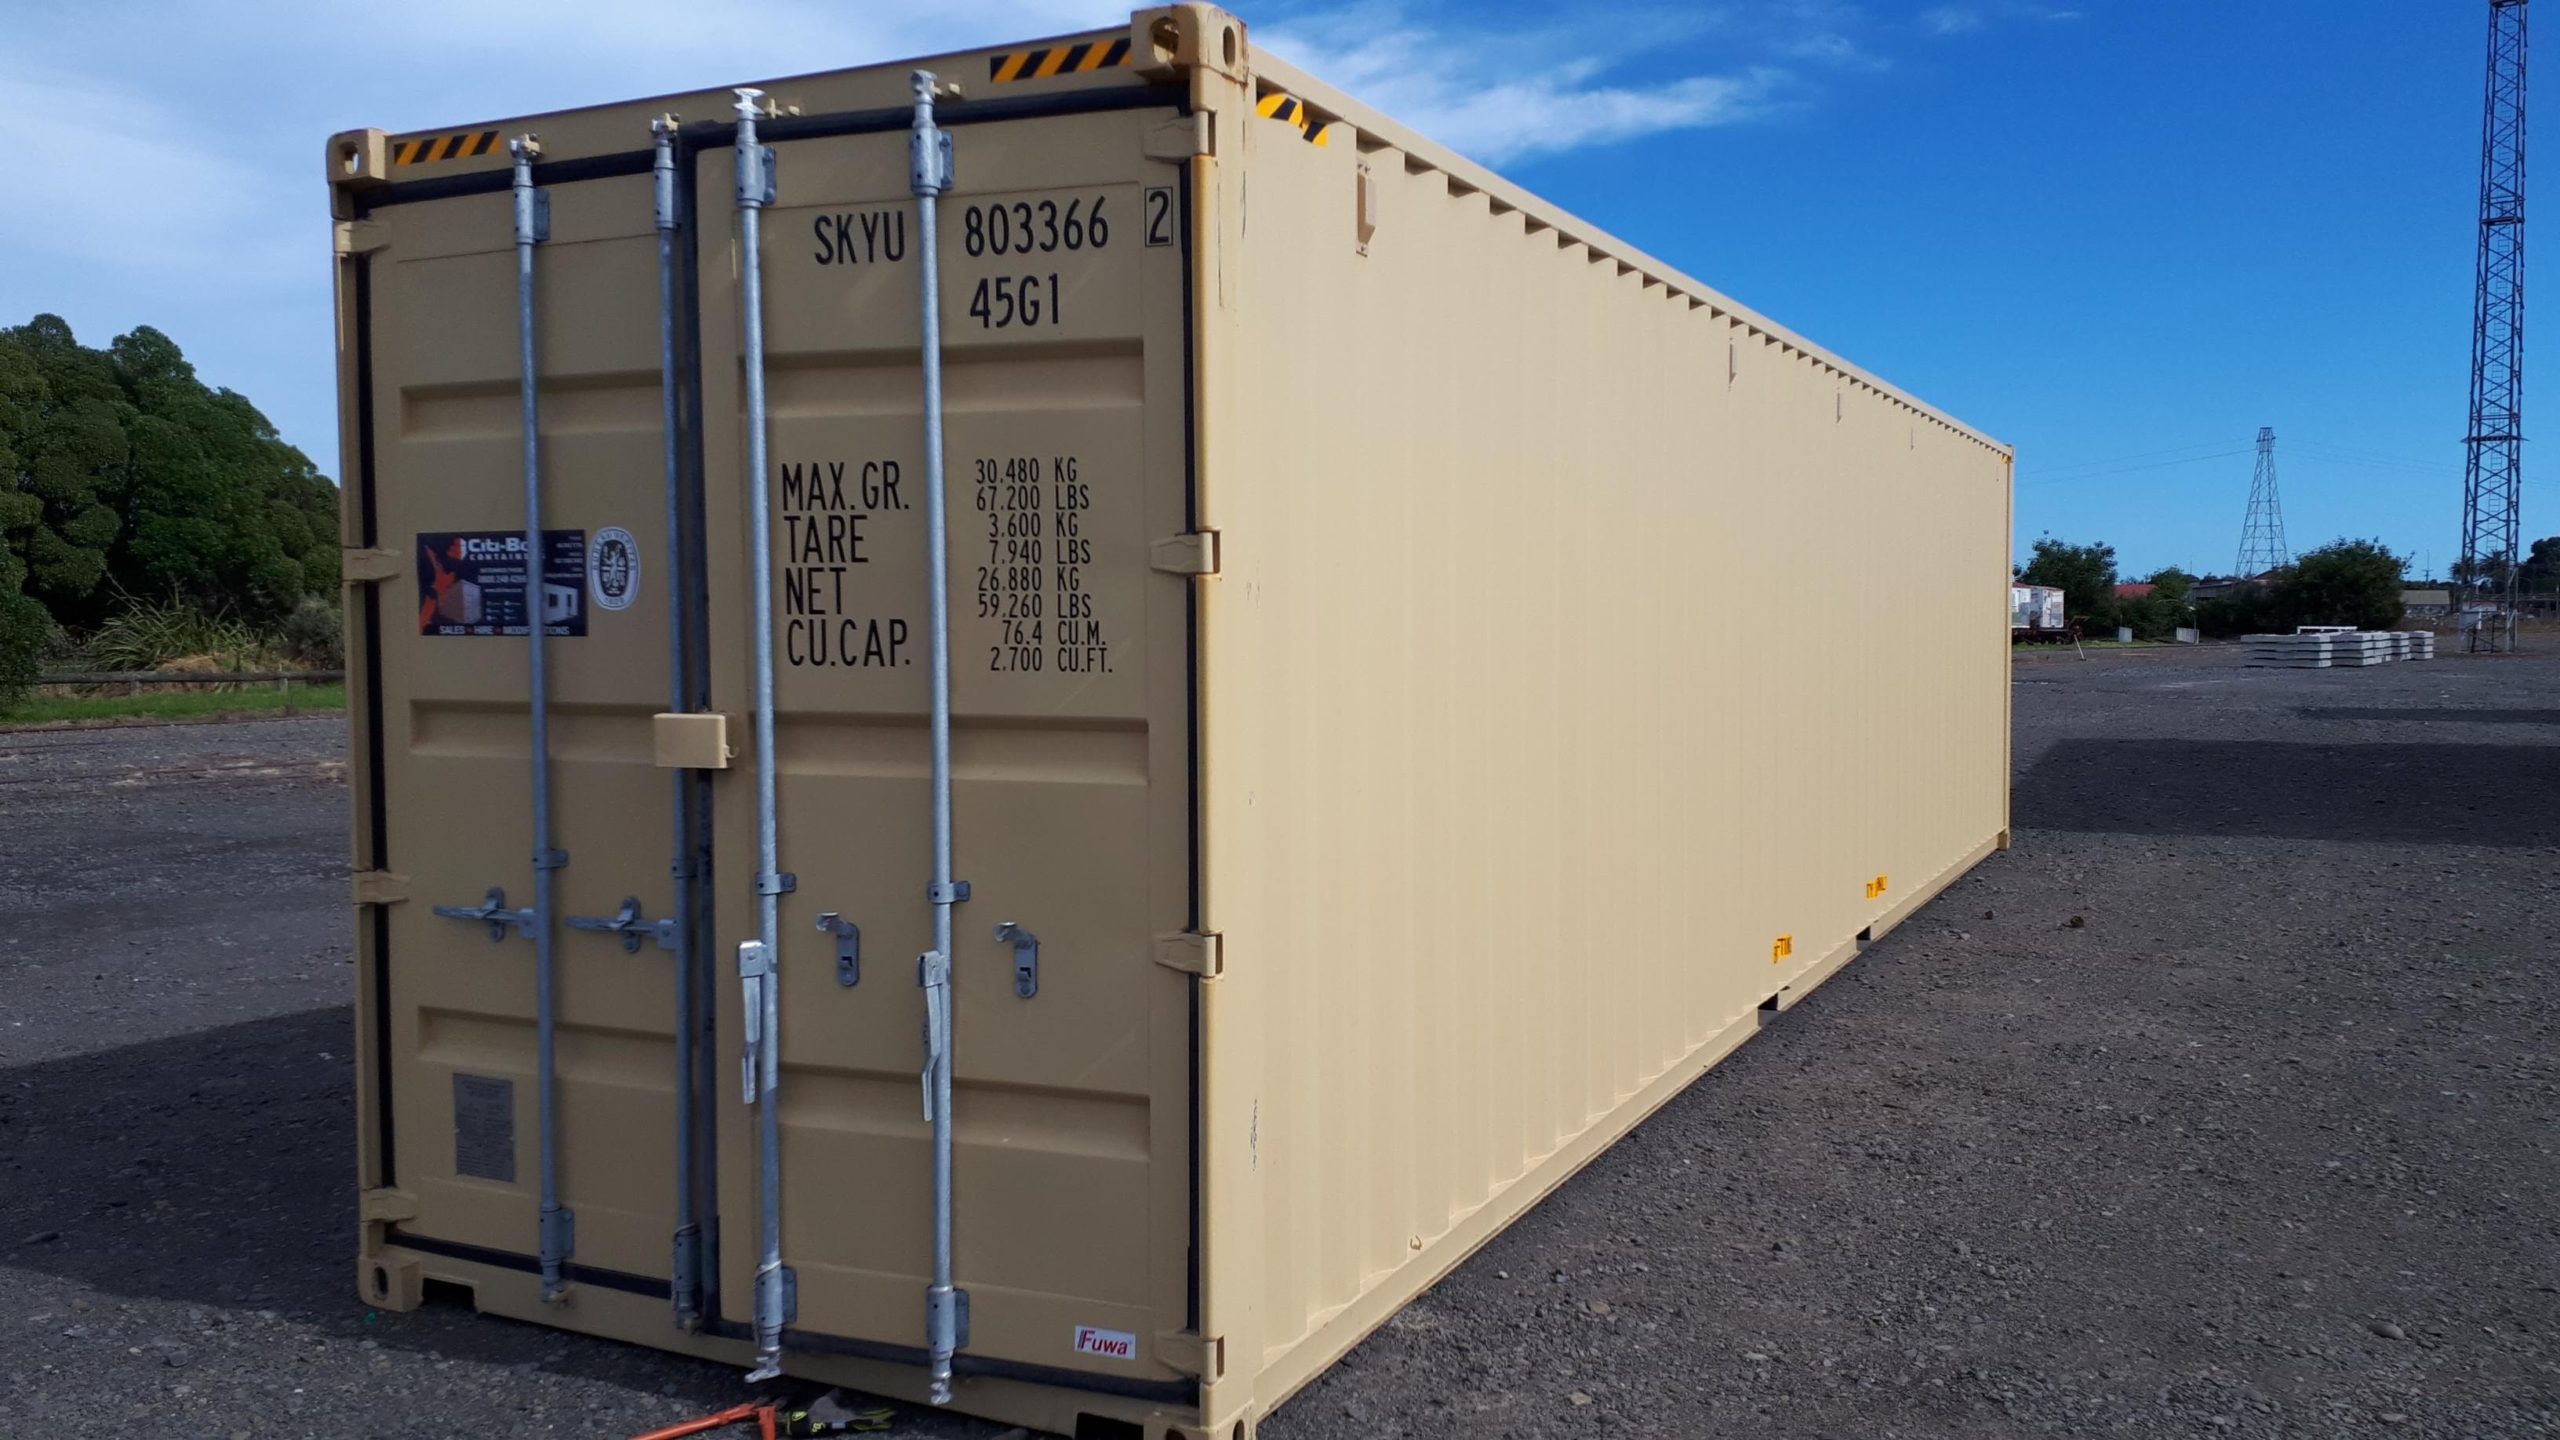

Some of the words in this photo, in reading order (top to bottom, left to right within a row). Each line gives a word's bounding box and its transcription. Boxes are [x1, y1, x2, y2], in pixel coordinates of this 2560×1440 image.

[815, 211, 904, 265] SKYU
[966, 196, 1108, 257] 803366
[1149, 191, 1170, 243] 2
[970, 274, 1058, 328] 45G1
[976, 458, 1039, 483] 30.480
[1055, 457, 1076, 482] KG
[782, 461, 909, 511] MAX.GR.
[977, 485, 1039, 510] 67.200
[1056, 485, 1089, 510] LBS
[989, 513, 1040, 537] 3.600
[1056, 512, 1077, 537] KG
[468, 536, 528, 552] Citi-Bo
[784, 515, 868, 563] TARE
[990, 540, 1041, 564] 7.940
[1057, 539, 1090, 564] LBS
[786, 567, 846, 614] NET
[978, 567, 1041, 591] 26.880
[1058, 567, 1079, 591] KG
[979, 593, 1041, 618] 59.260
[1058, 594, 1091, 618] LBS
[788, 619, 910, 666] CU.CAP.
[1003, 620, 1042, 644] 76.4
[1058, 621, 1105, 645] CU.M.
[991, 647, 1042, 671] 2.700
[1058, 648, 1112, 672] CU.FT.
[1079, 1329, 1128, 1355] Fuwa
